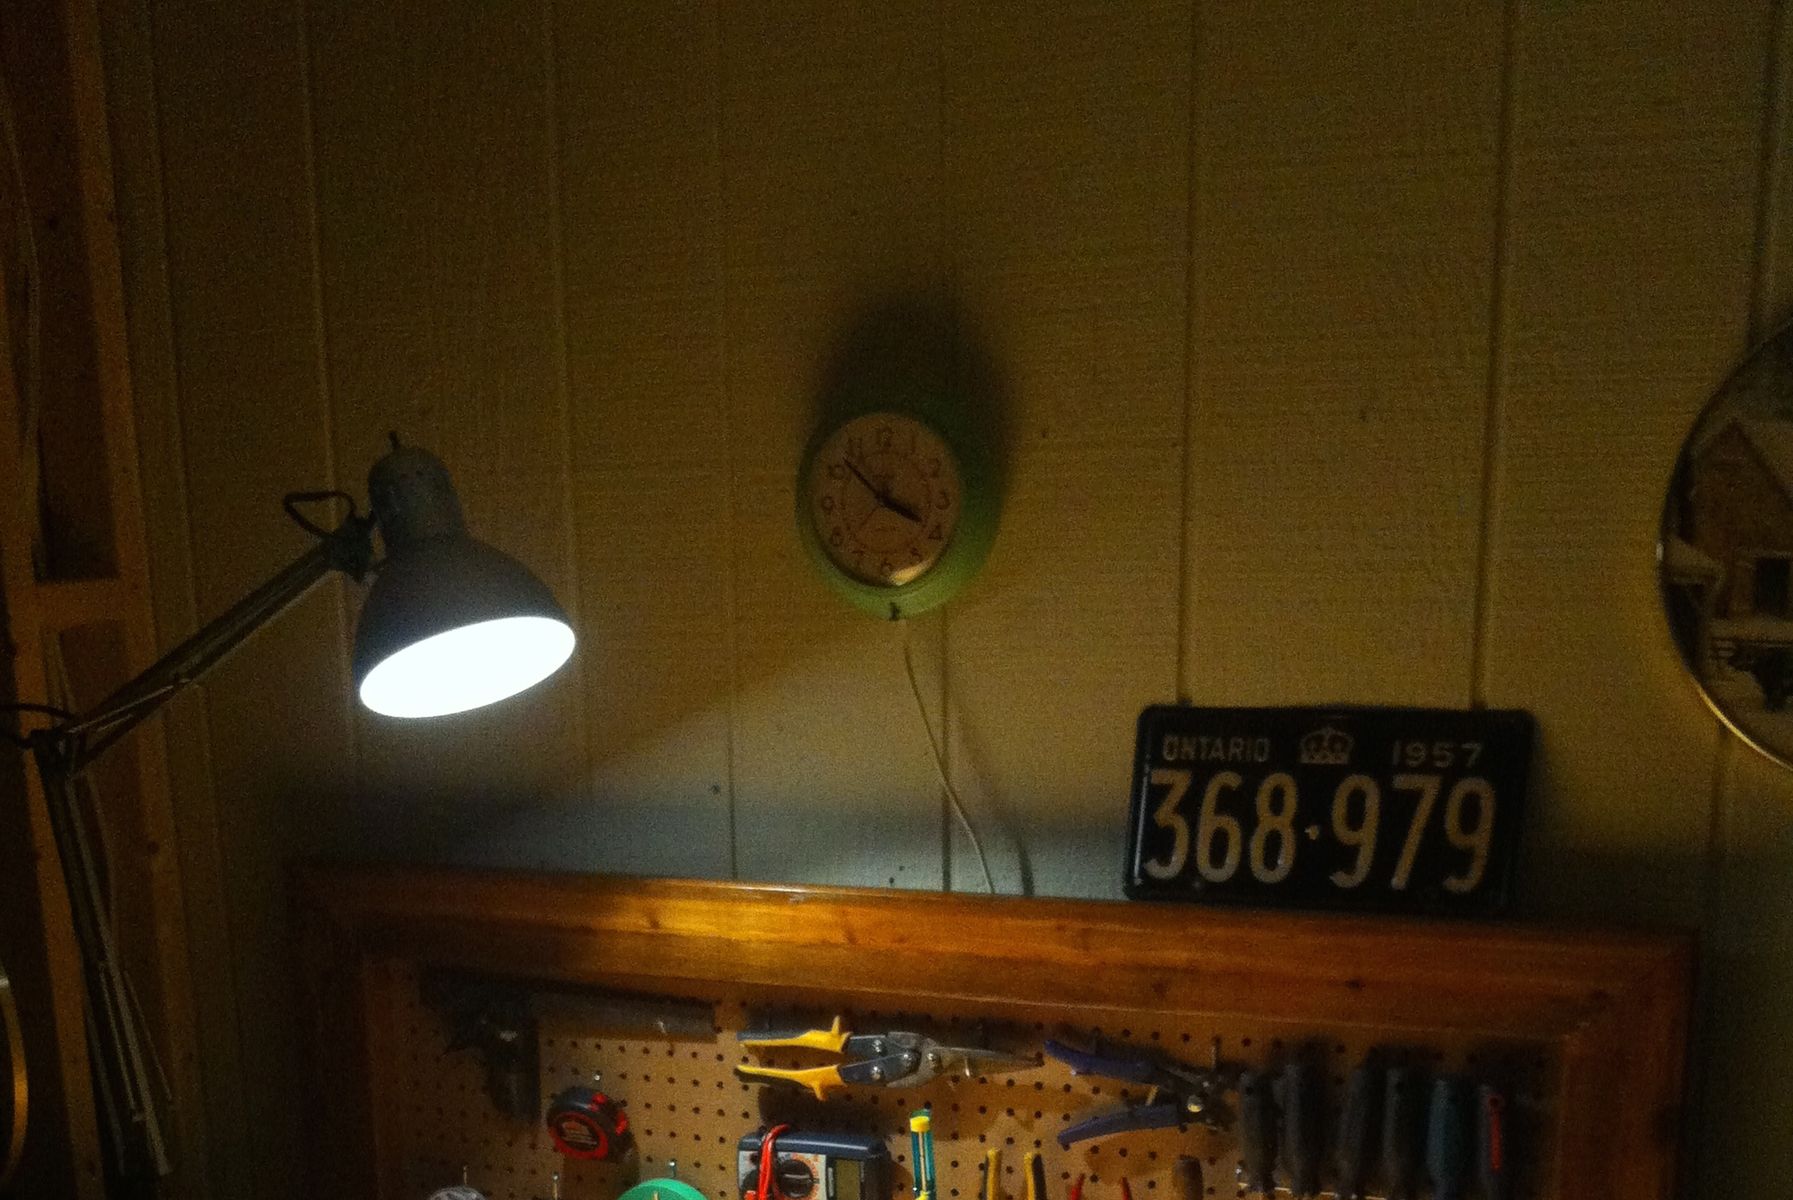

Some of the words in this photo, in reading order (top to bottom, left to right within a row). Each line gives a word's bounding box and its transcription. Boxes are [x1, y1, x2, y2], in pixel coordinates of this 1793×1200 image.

[934, 489, 951, 511] 3
[927, 523, 943, 541] 4
[1161, 734, 1271, 763] ONTARIO
[1391, 740, 1484, 769] 1957
